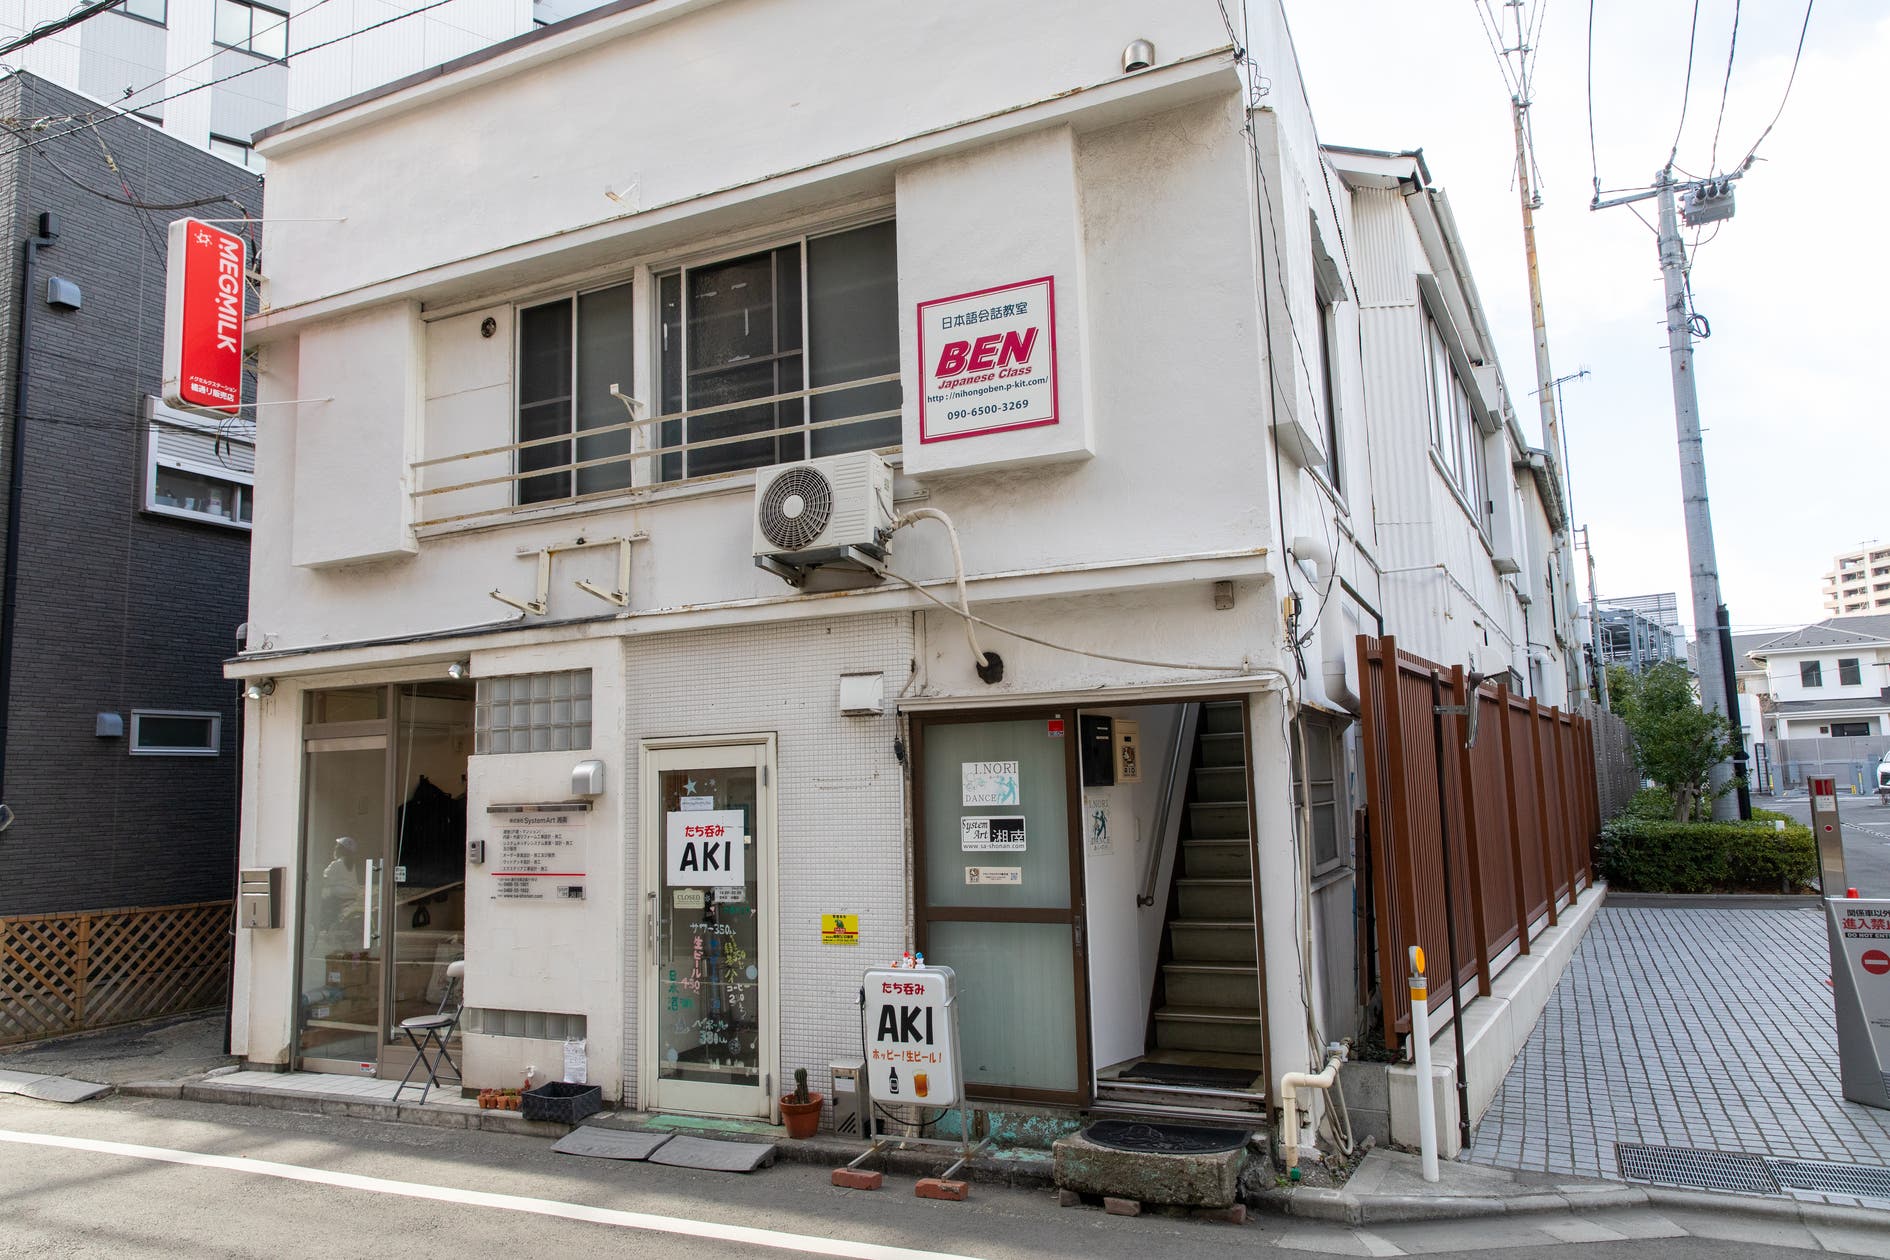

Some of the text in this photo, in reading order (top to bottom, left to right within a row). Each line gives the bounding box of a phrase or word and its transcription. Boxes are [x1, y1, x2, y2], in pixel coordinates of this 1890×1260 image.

[215, 237, 239, 353] MEGMILK
[942, 301, 1028, 330] 日本語会話教室
[935, 327, 1039, 378] BEN
[938, 365, 1032, 390] Japanese Class
[947, 399, 1029, 421] 090-6500-3269
[965, 794, 997, 803] DANCE
[685, 824, 725, 838] たち呑み
[962, 819, 988, 833] System
[973, 830, 988, 840] Art
[992, 829, 1024, 842] 湘南
[680, 841, 731, 871] AKI
[881, 982, 925, 996] たち呑み
[877, 1004, 934, 1045] AKI
